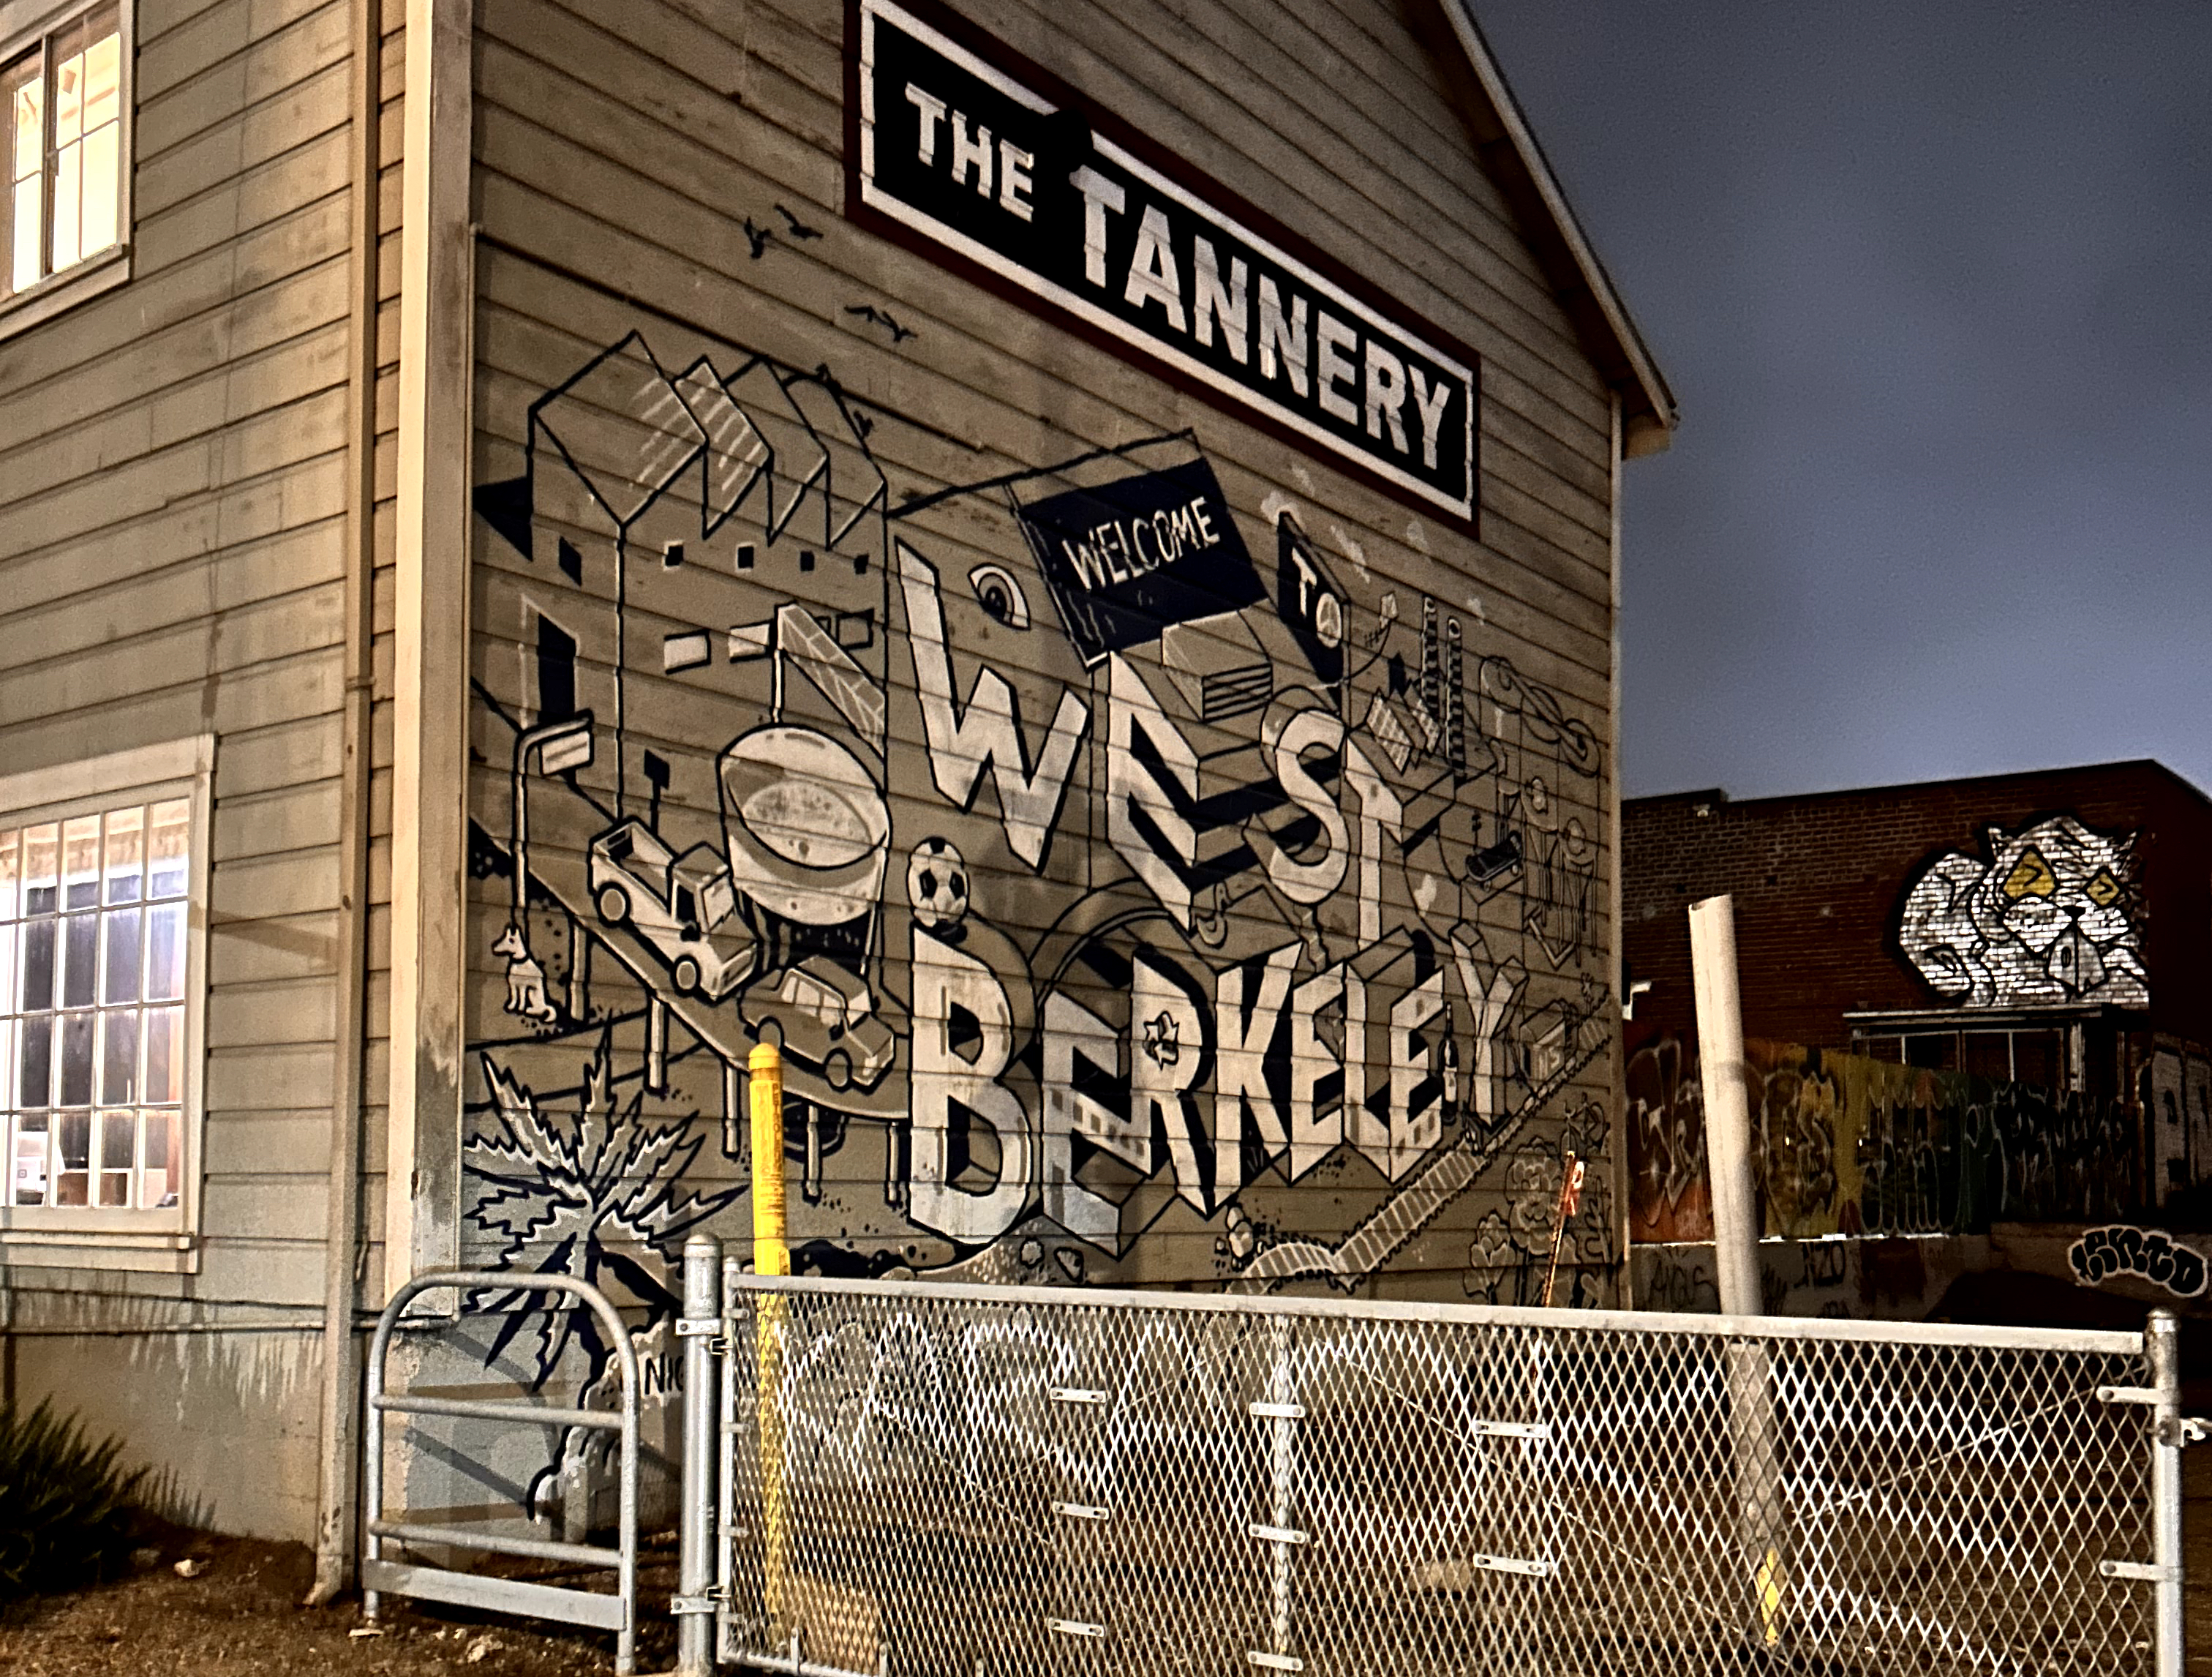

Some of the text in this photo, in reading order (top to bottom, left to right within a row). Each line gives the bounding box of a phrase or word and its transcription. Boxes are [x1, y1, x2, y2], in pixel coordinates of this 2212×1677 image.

[906, 81, 1451, 470] THE TANNERY
[1062, 495, 1220, 590] WELCOME
[1292, 546, 1343, 648] TO
[895, 535, 1404, 952] WEST
[910, 923, 1526, 1260] BERKELEY
